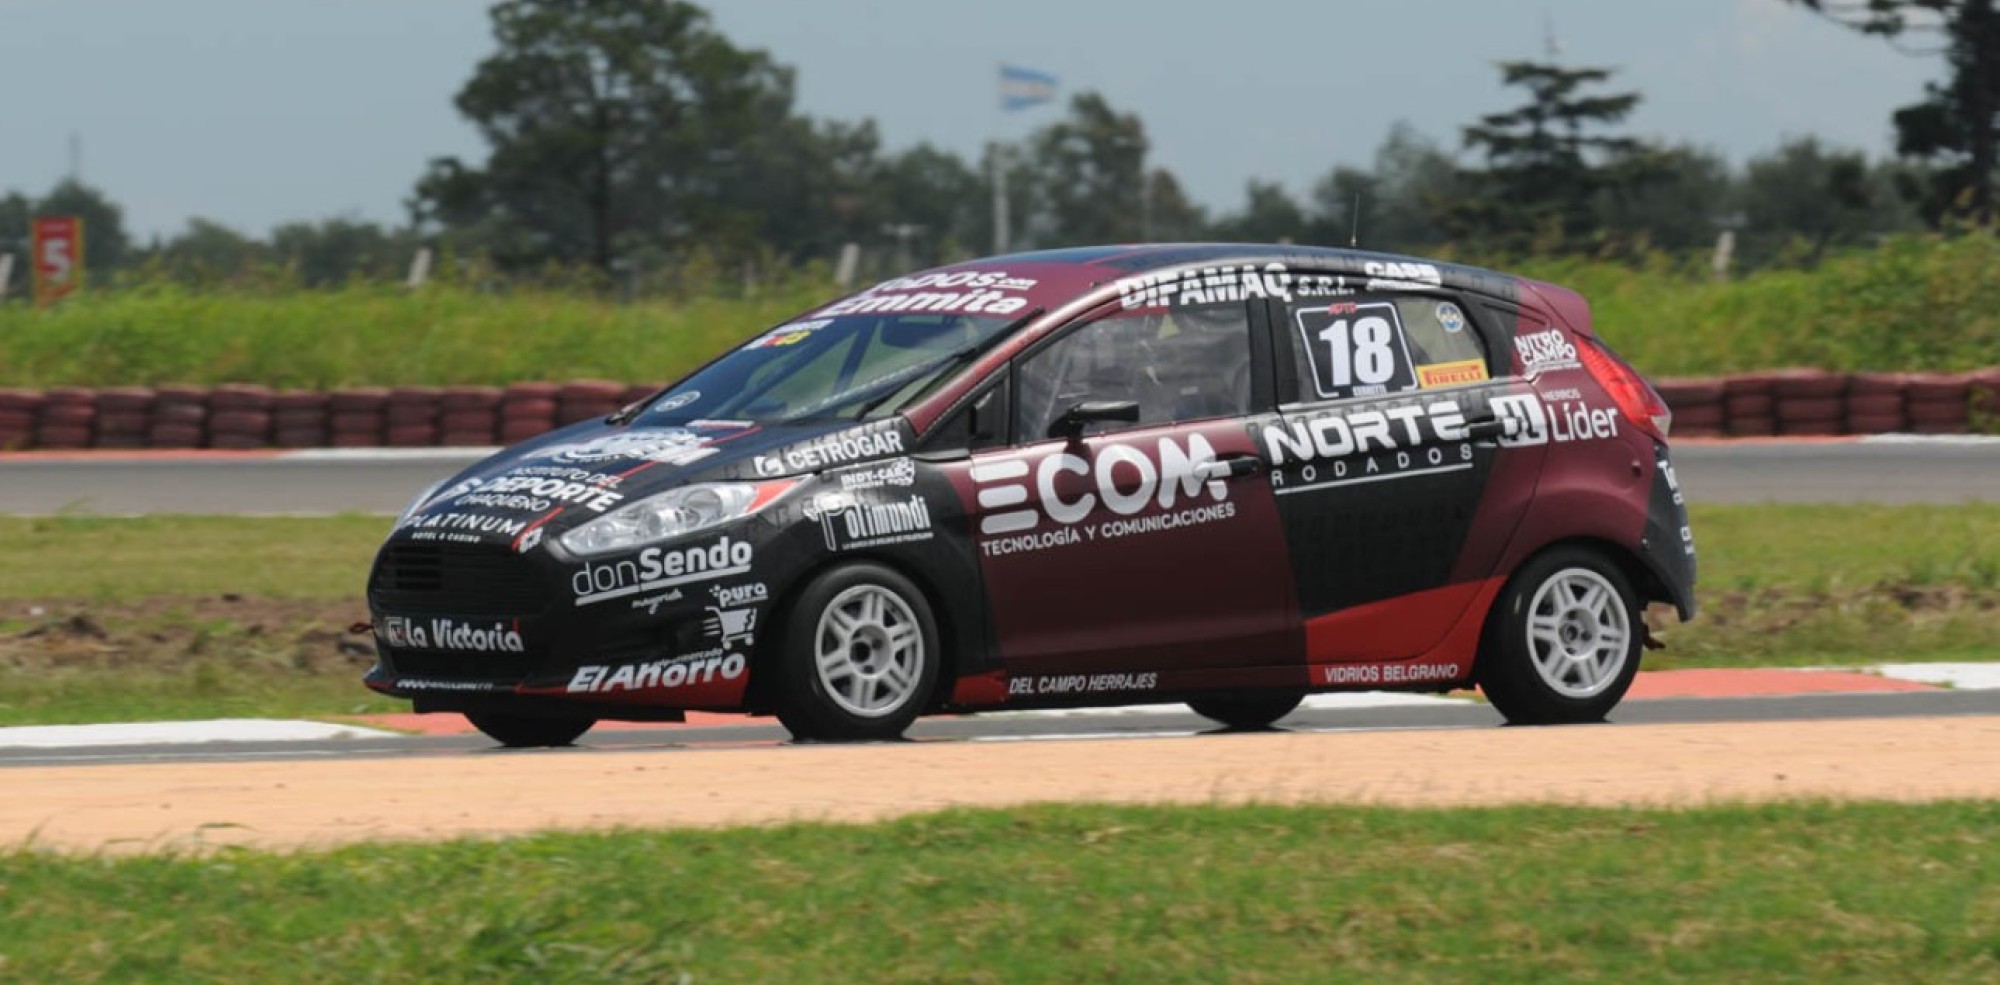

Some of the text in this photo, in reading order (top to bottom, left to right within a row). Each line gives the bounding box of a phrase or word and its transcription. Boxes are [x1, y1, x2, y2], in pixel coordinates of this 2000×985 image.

[43, 239, 71, 283] 5
[1115, 262, 1355, 310] DIFAMAQ S.R.L.
[1318, 316, 1395, 387] 18
[1514, 329, 1565, 354] NITRO
[1521, 342, 1577, 366] CAMPO
[1423, 365, 1483, 386] PIRELLI
[1263, 400, 1470, 465] NORTE
[1547, 402, 1619, 441] Líder
[787, 430, 904, 469] CETROGAR
[1271, 443, 1473, 486] RODADOS
[475, 476, 625, 513] DEPORTE
[970, 432, 1228, 533] ECOM
[406, 512, 527, 537] PLATINUM
[981, 501, 1236, 556] TECNOLOGÍA Y COMUNICACIONES
[432, 618, 525, 651] Victoria
[1009, 672, 1157, 694] DEL CAMPO HERRAJES
[1325, 664, 1459, 683] VIDRIOS BELGRANO
